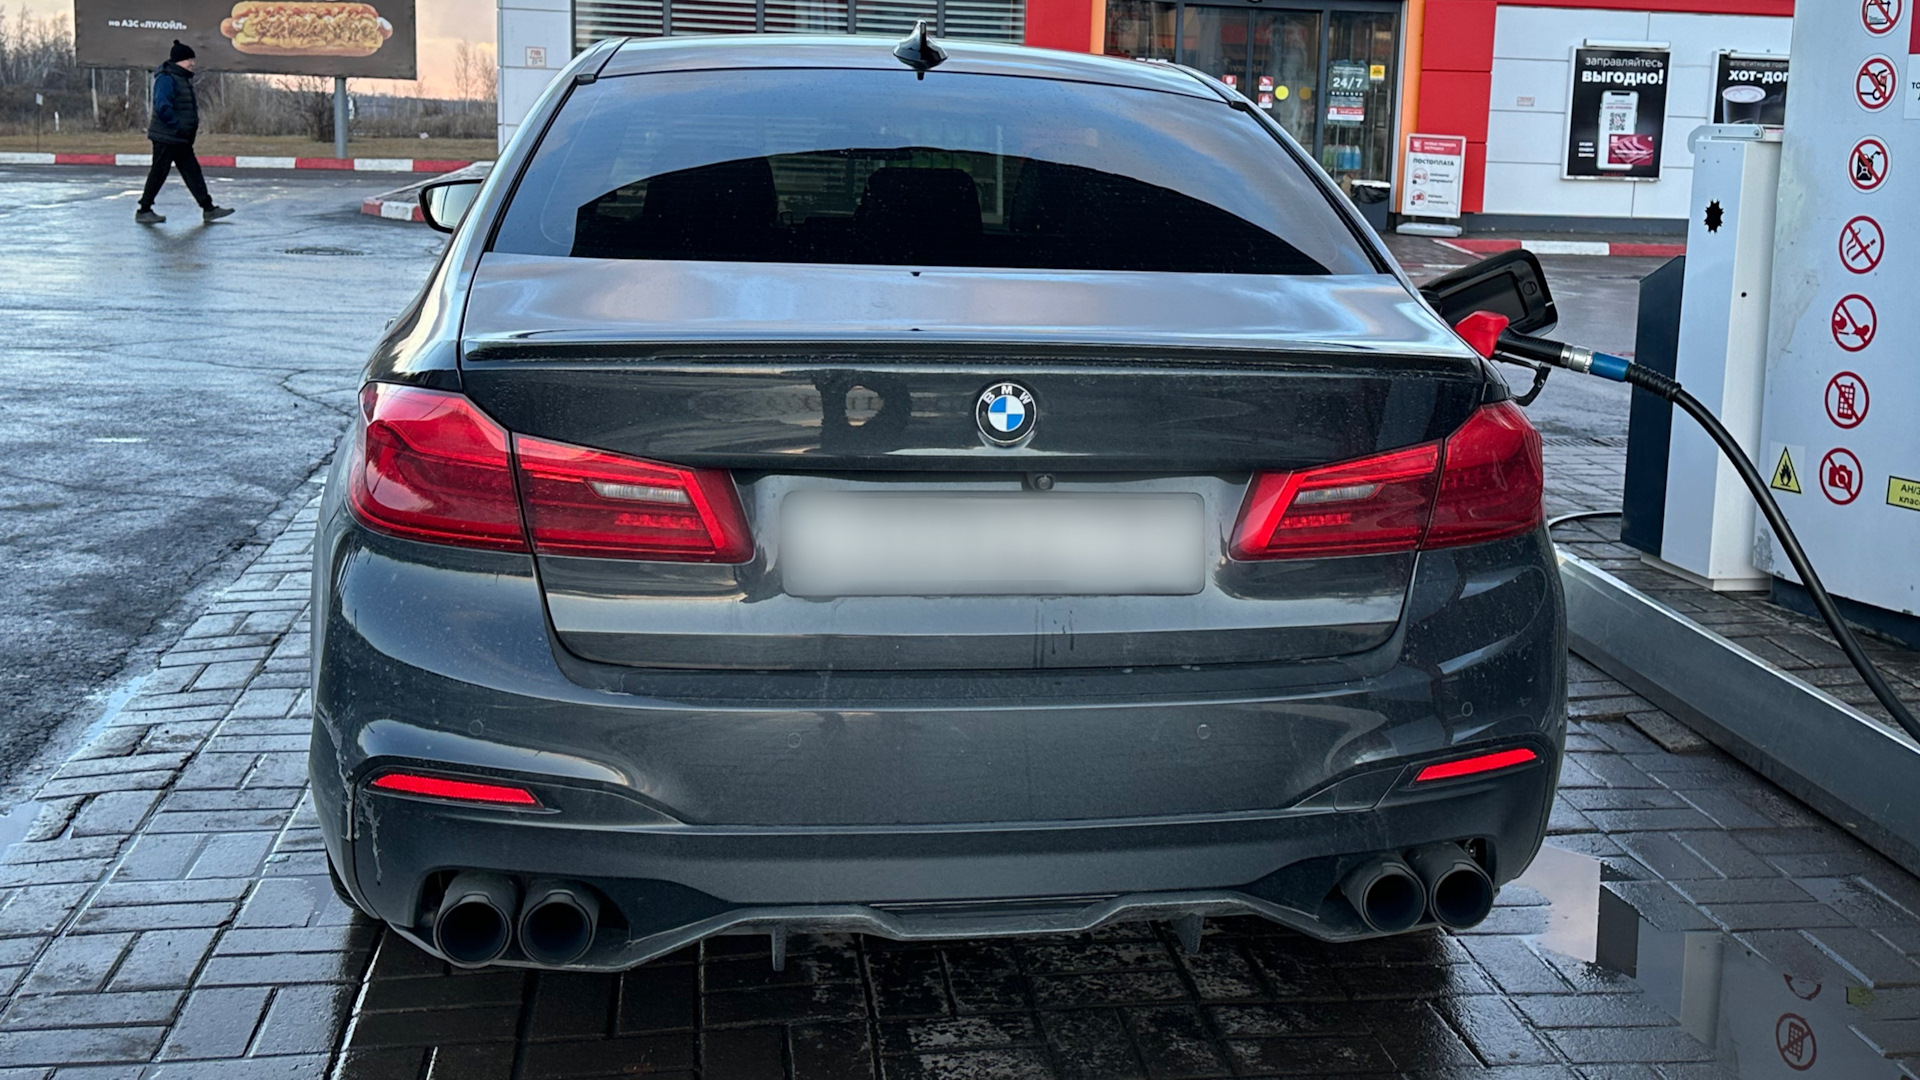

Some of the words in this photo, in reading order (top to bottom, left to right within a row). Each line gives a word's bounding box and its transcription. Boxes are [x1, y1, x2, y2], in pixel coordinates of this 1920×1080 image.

[121, 19, 139, 28] АЗС
[1585, 57, 1664, 68] заправляйтесь
[1332, 76, 1364, 90] 24/7
[1581, 69, 1665, 87] выгодно!
[1412, 157, 1455, 167] ПОСТОПЛАТА
[982, 385, 1032, 405] BMW
[1899, 496, 1920, 505] клас
